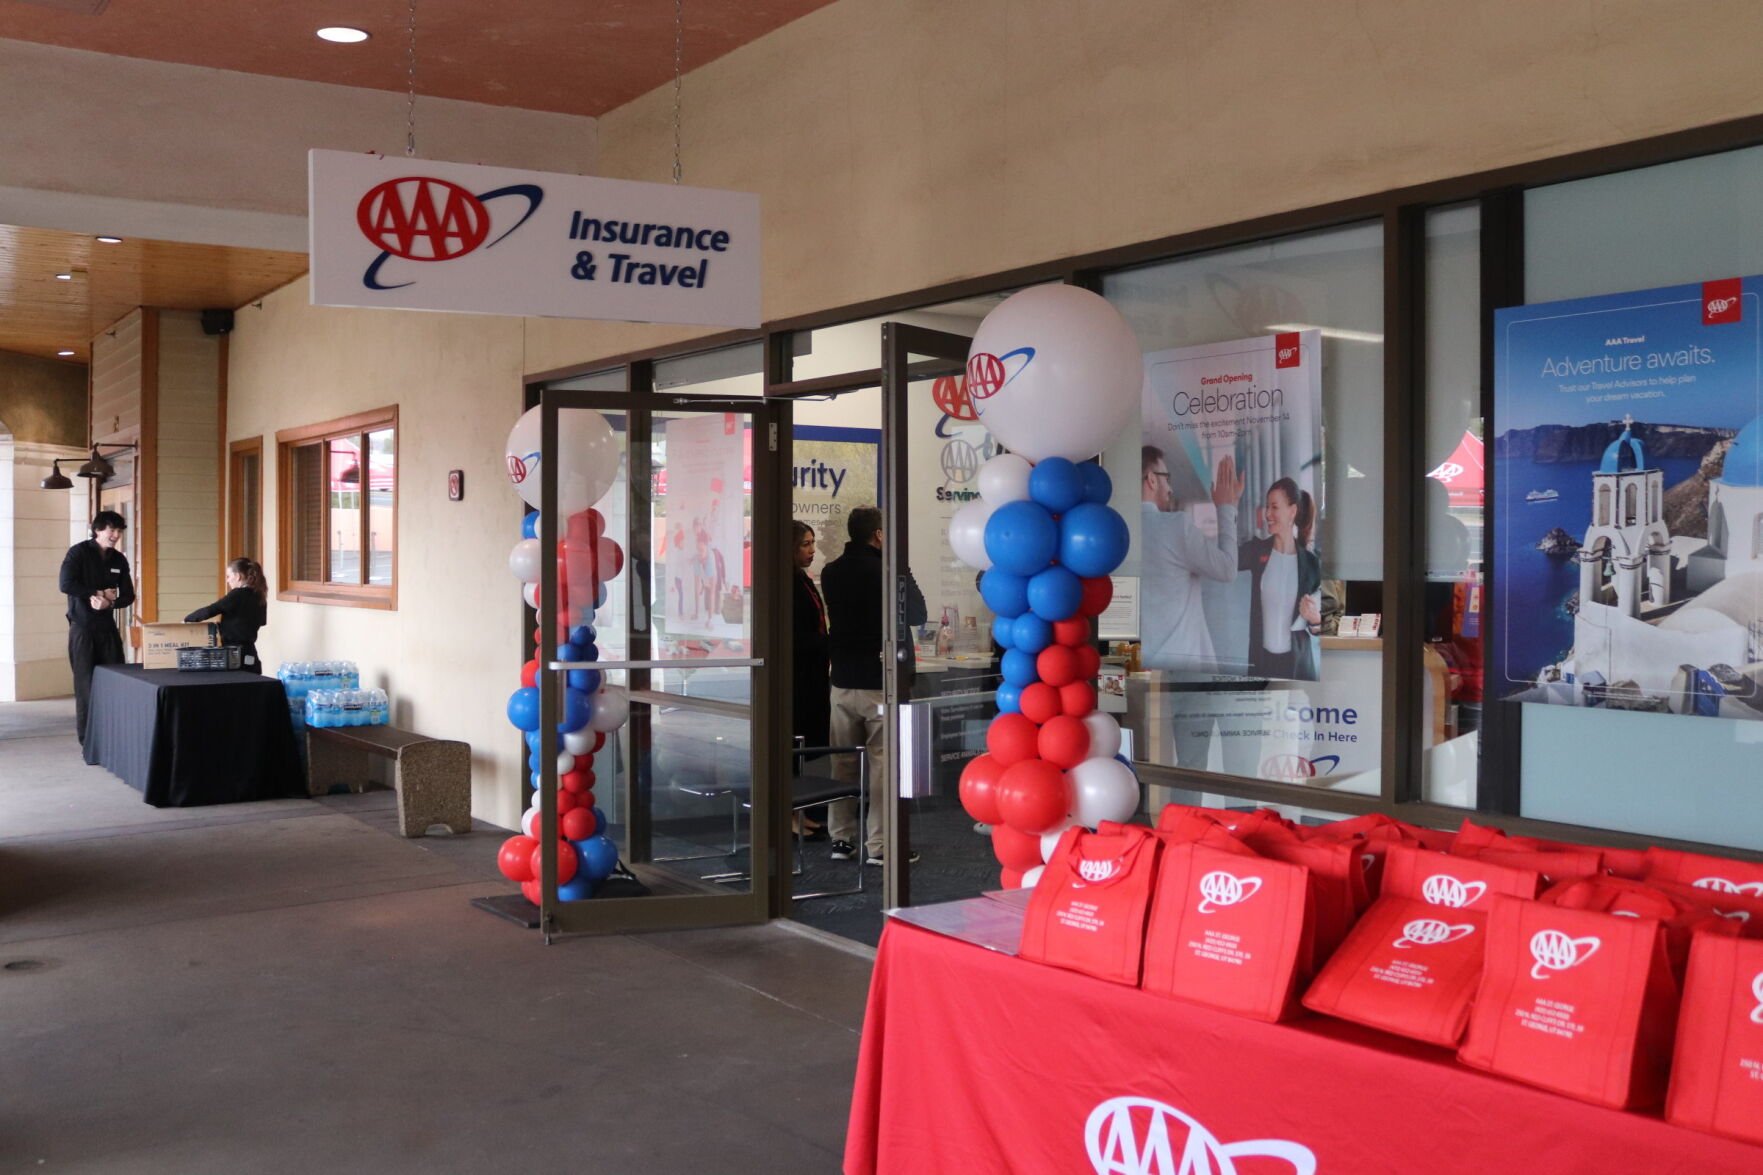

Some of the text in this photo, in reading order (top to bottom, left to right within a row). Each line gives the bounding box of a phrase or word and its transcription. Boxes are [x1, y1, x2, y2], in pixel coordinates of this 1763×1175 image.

[357, 177, 490, 261] AAA
[569, 210, 730, 252] Insurance
[570, 250, 708, 289] & Travel
[1605, 335, 1645, 346] AAA Travel
[1541, 344, 1716, 378] Adventure awaits.
[1201, 373, 1253, 385] Grand Opening
[1649, 377, 1658, 385] to
[1173, 384, 1283, 416] Celebration
[1314, 730, 1325, 741] In
[1328, 731, 1358, 743] Here
[1200, 870, 1243, 906] AAA
[1422, 874, 1467, 908] AAA
[1403, 919, 1450, 944] AAA
[1530, 929, 1577, 970] AAA
